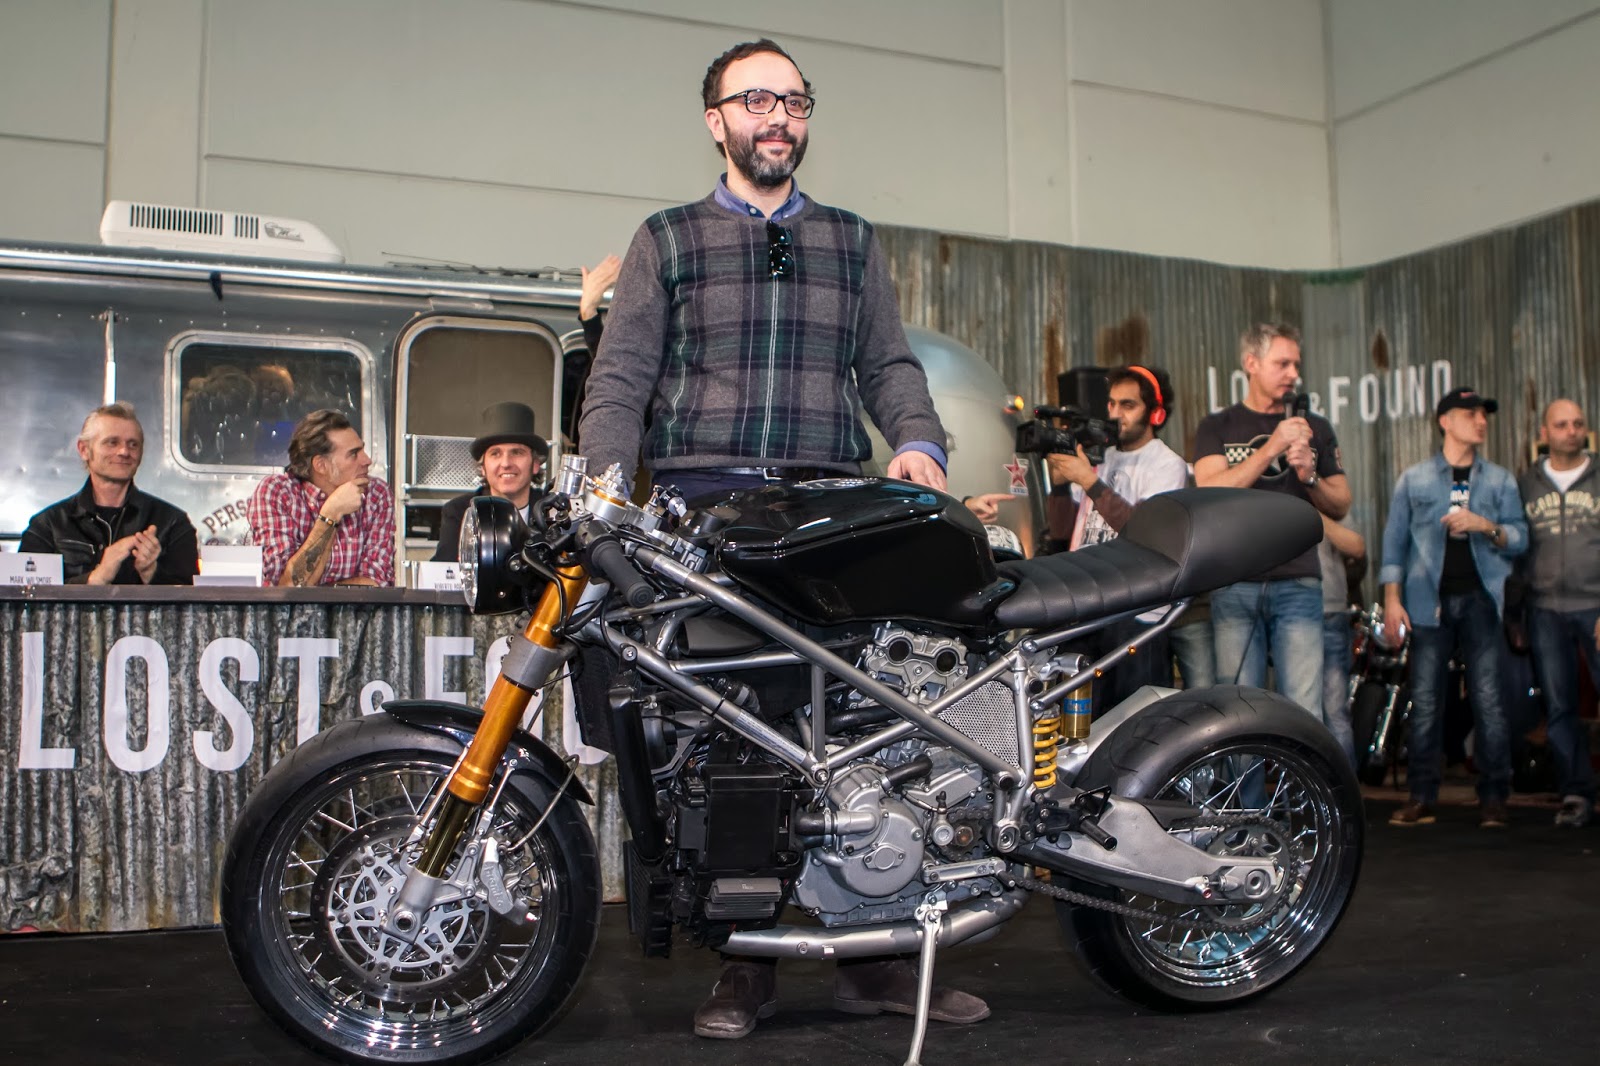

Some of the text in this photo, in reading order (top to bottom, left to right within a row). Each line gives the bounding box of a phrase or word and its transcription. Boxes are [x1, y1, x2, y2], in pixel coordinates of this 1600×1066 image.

[1329, 360, 1452, 424] FOUND
[202, 498, 252, 534] PERS
[18, 631, 340, 772] LOST
